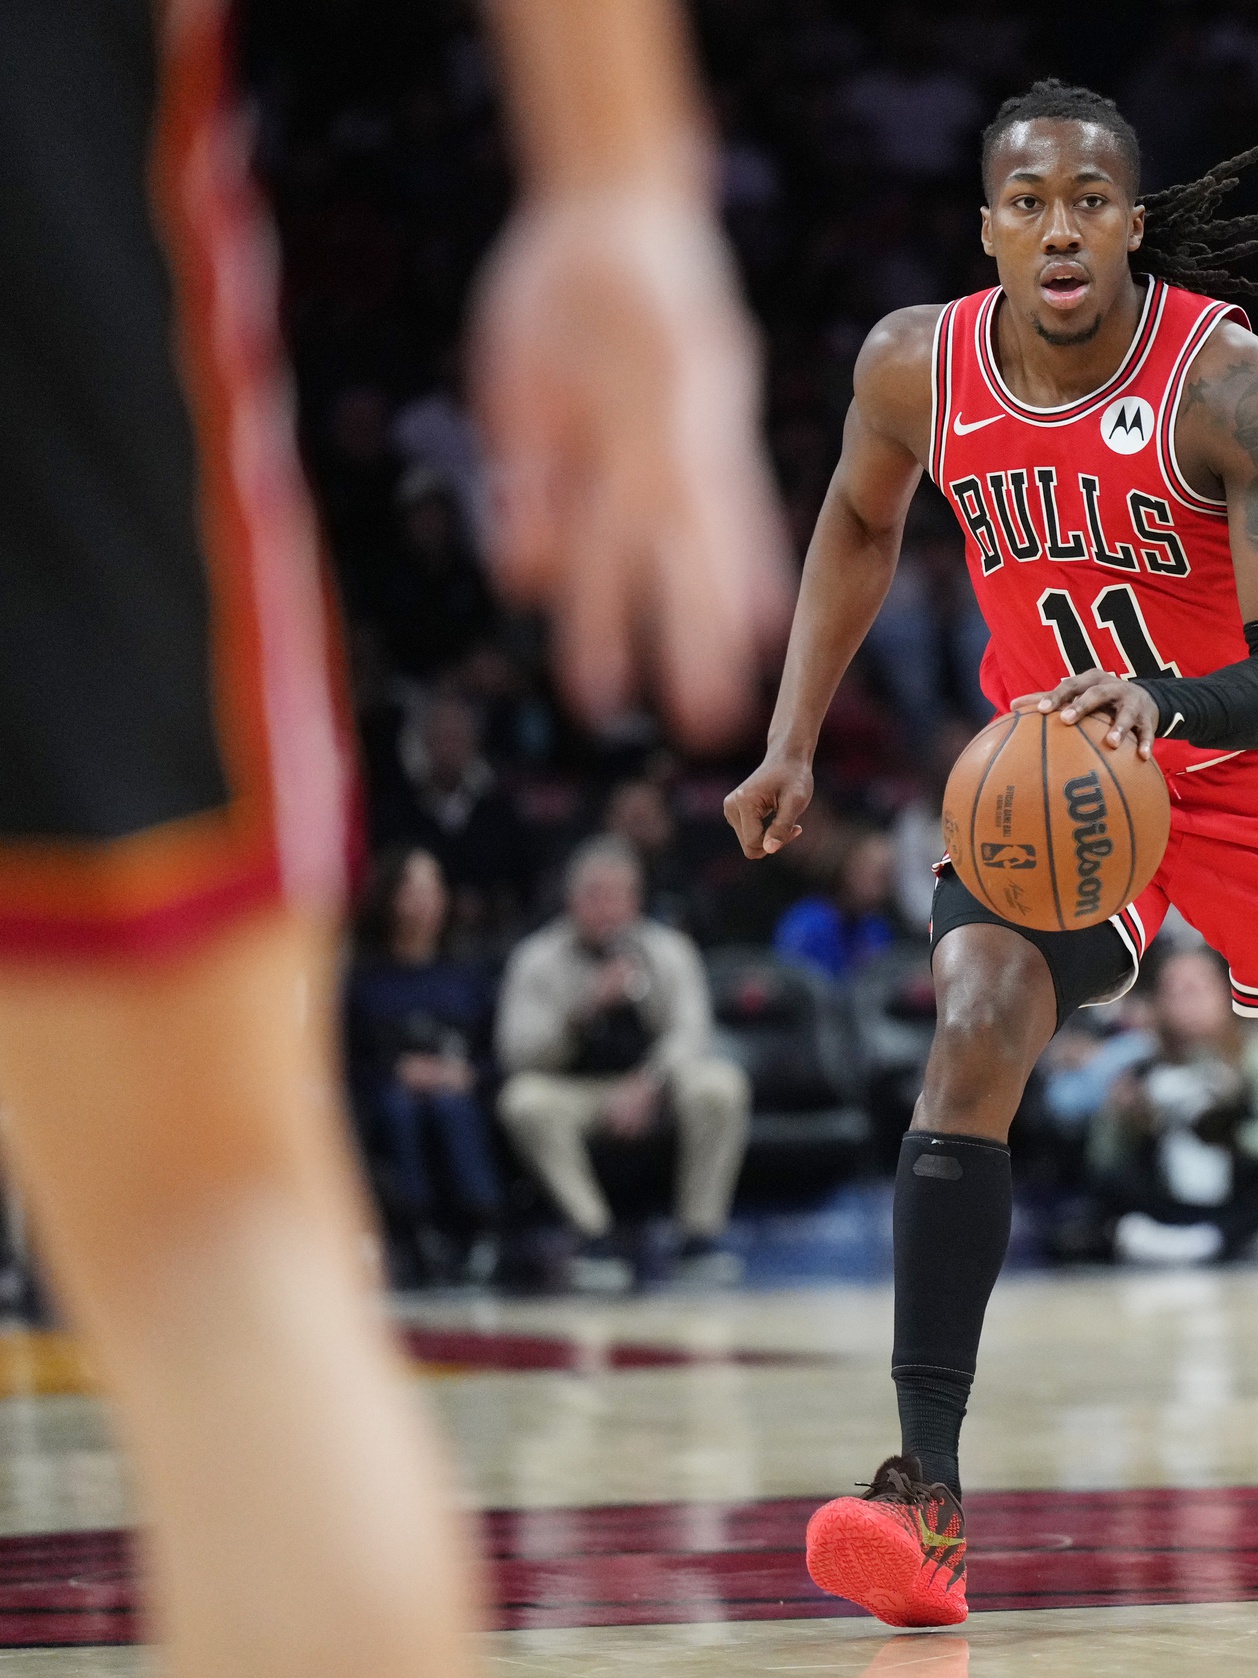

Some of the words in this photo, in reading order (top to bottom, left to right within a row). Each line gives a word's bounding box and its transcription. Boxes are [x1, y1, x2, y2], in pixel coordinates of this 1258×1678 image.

[949, 466, 1192, 578] BULLS
[1036, 583, 1183, 683] 11
[1003, 809, 1013, 824] GAME
[1003, 825, 1012, 838] BALL
[1064, 770, 1114, 917] Wilson
